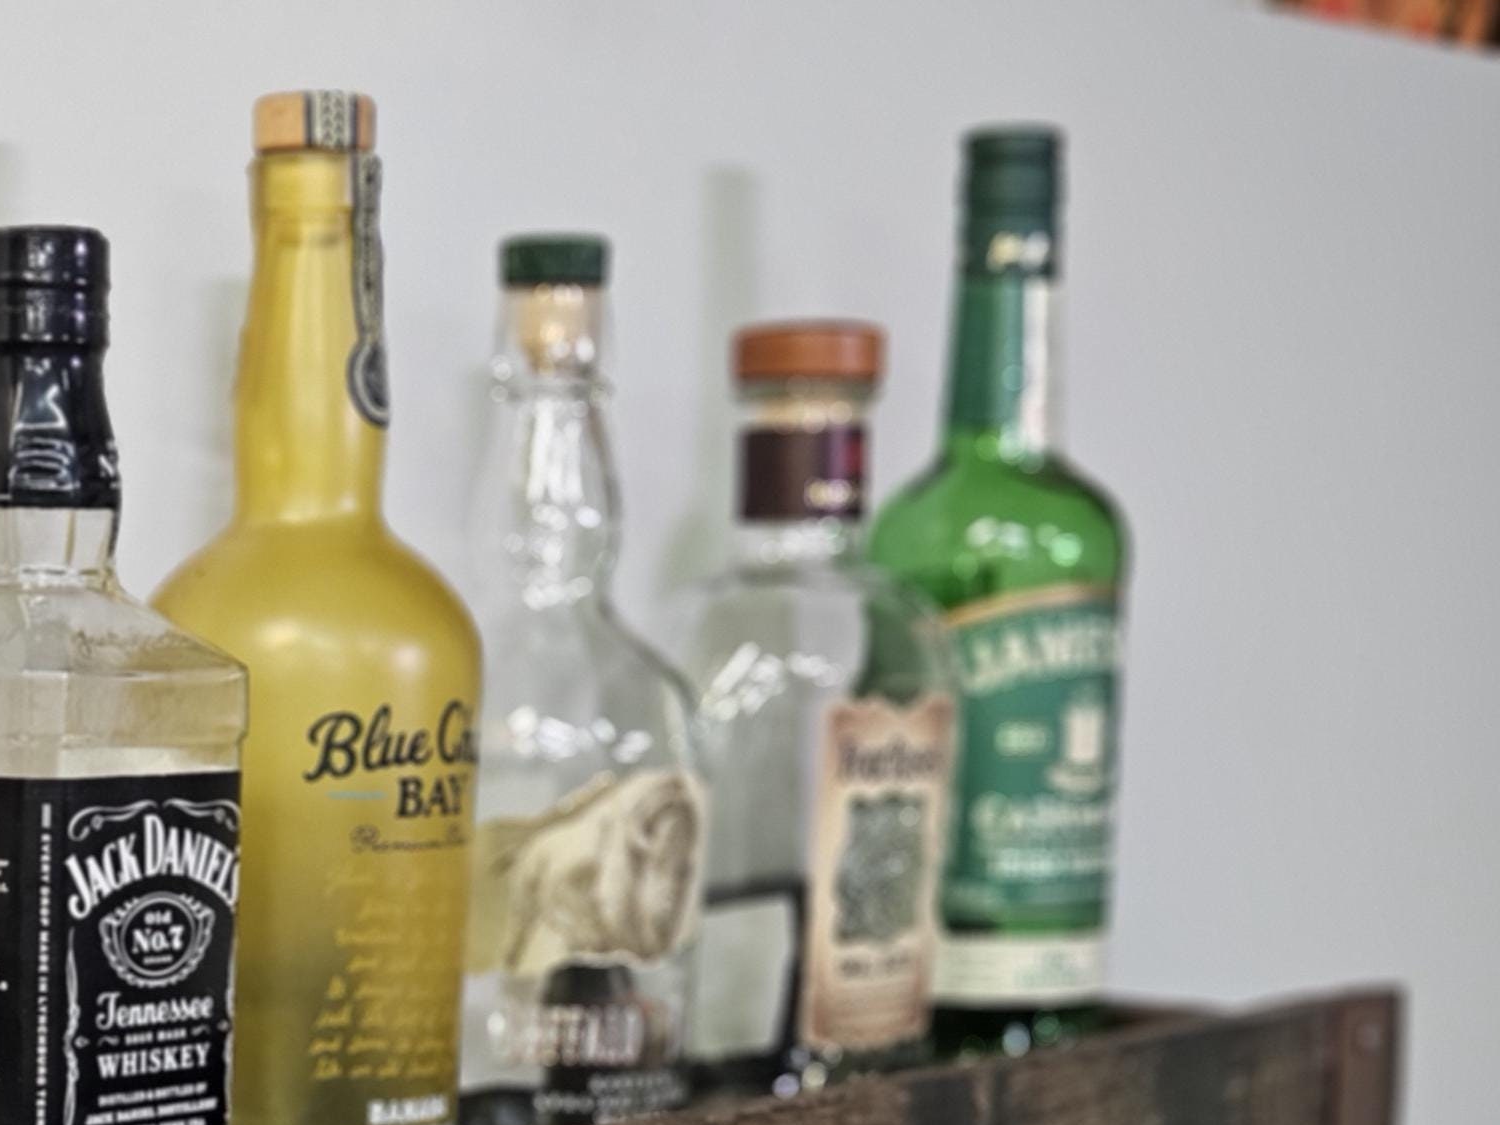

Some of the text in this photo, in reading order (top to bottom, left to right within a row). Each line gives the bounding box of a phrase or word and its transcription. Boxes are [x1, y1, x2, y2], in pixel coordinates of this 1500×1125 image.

[302, 702, 435, 783] Blue
[64, 832, 144, 920] JACK
[144, 910, 173, 925] Old
[95, 990, 214, 1031] Tennessee
[96, 1041, 212, 1079] WHISKEY
